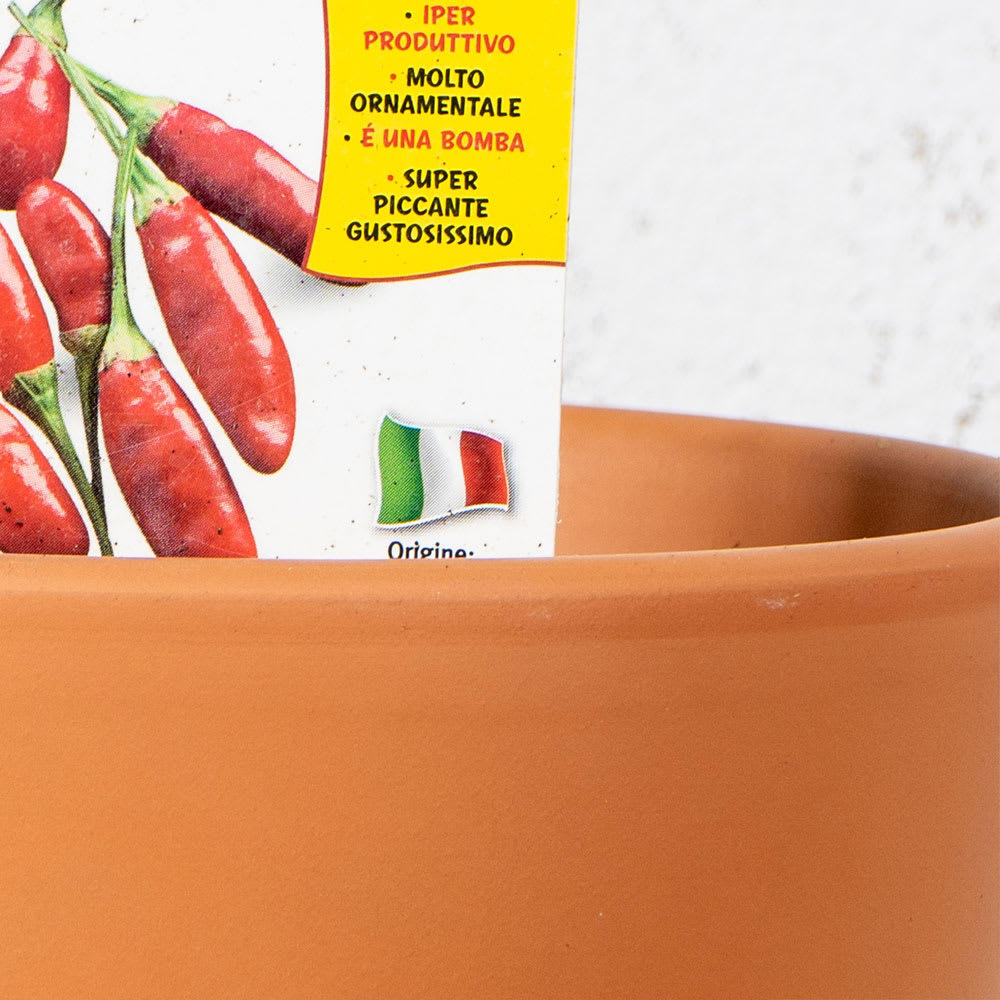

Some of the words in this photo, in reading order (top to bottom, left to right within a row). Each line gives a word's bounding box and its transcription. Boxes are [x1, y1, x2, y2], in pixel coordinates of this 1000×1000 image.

[423, 4, 476, 26] IPER
[363, 30, 515, 54] PRODUTTIVO
[406, 67, 485, 89] MOLTO
[350, 93, 522, 117] ORNAMENTALE
[382, 128, 432, 149] UNA
[440, 130, 525, 153] BOMBA
[403, 168, 478, 190] SUPER
[373, 194, 489, 218] PICCANTE
[346, 221, 514, 246] GUSTOSISSIMO
